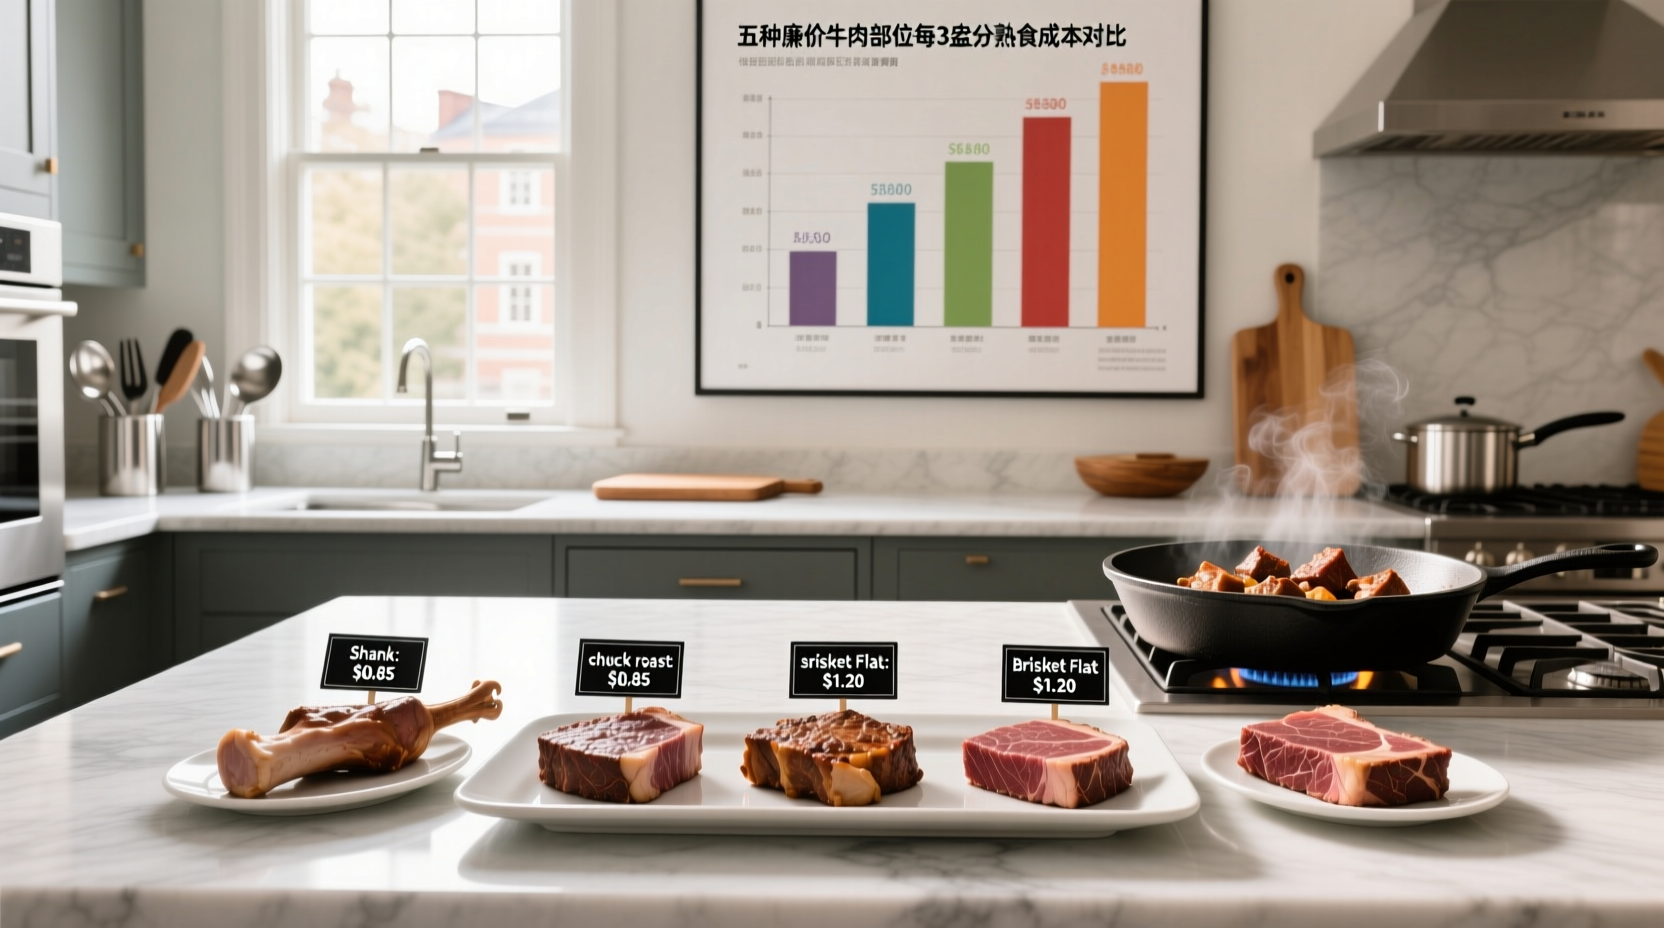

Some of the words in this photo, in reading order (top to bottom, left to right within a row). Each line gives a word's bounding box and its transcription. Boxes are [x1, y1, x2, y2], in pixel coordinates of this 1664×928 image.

[349, 645, 400, 662] Shank:
[588, 651, 632, 668] chuck
[635, 655, 674, 668] roast
[800, 652, 852, 669] srisket
[855, 653, 890, 670] Flat:
[352, 663, 396, 683] $0.85
[1012, 656, 1067, 673] Brisket
[1070, 658, 1100, 675] Flat
[822, 672, 865, 690] $1.20
[1032, 676, 1077, 695] $1.20
